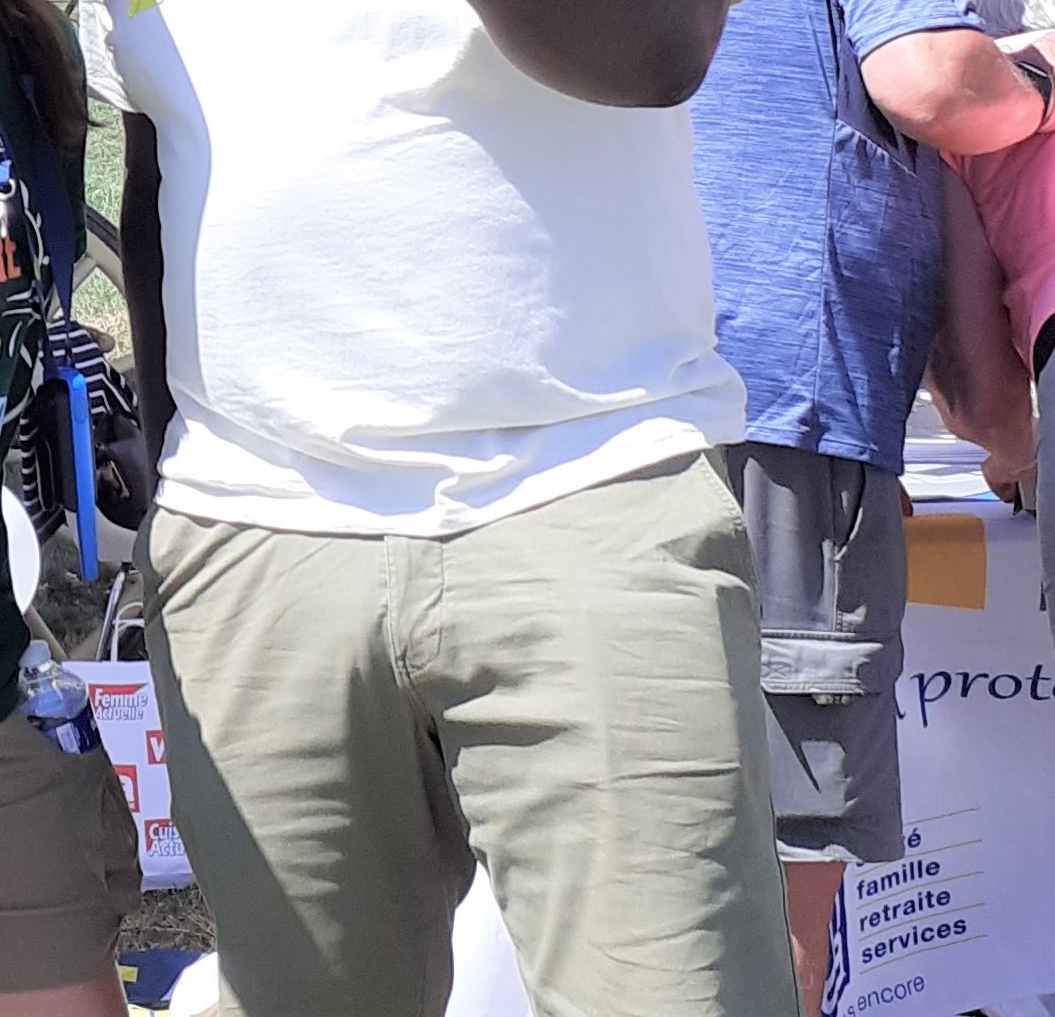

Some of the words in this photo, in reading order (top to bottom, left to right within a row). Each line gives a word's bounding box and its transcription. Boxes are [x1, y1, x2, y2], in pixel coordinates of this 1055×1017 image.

[94, 688, 149, 709] Femme
[856, 859, 941, 901] famille
[859, 890, 952, 933] retraite
[860, 919, 968, 965] services
[857, 975, 926, 1012] encore
